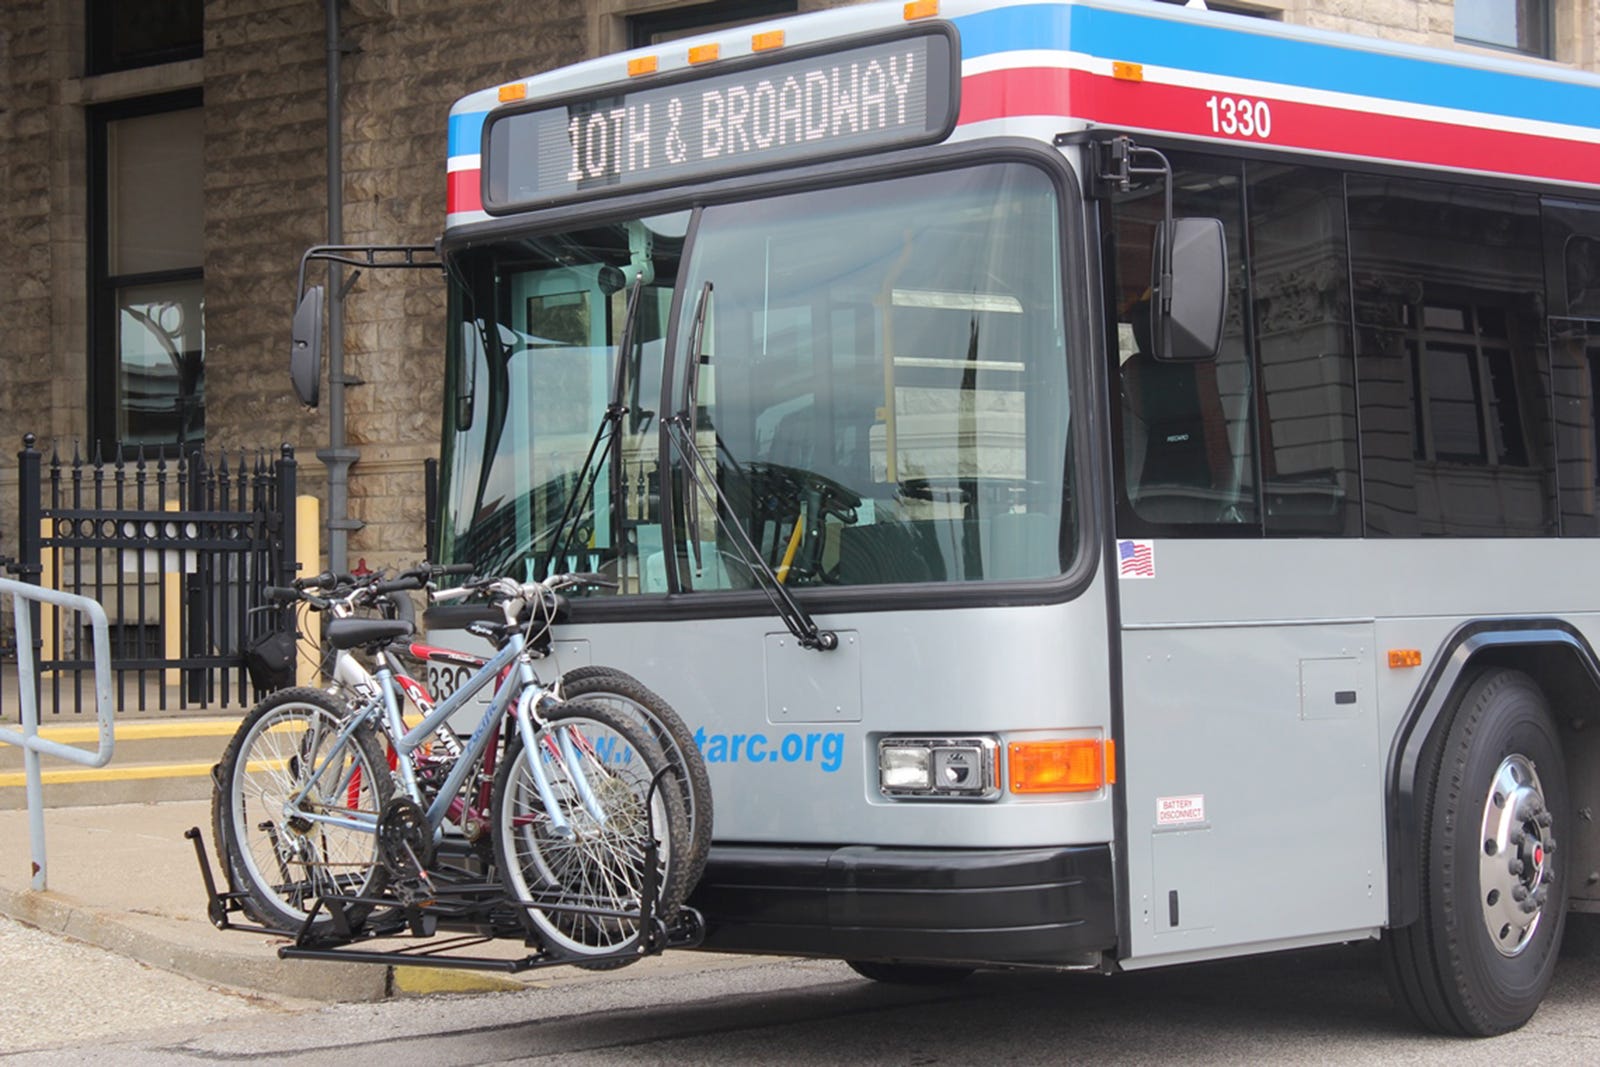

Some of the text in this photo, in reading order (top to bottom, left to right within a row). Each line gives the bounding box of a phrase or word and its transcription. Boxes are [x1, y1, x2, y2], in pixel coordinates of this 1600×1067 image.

[567, 53, 914, 181] 10TH & BROADWAY
[1206, 95, 1271, 138] 1330
[1160, 807, 1201, 820] DISCONNECT
[1163, 799, 1192, 809] BATTERY
